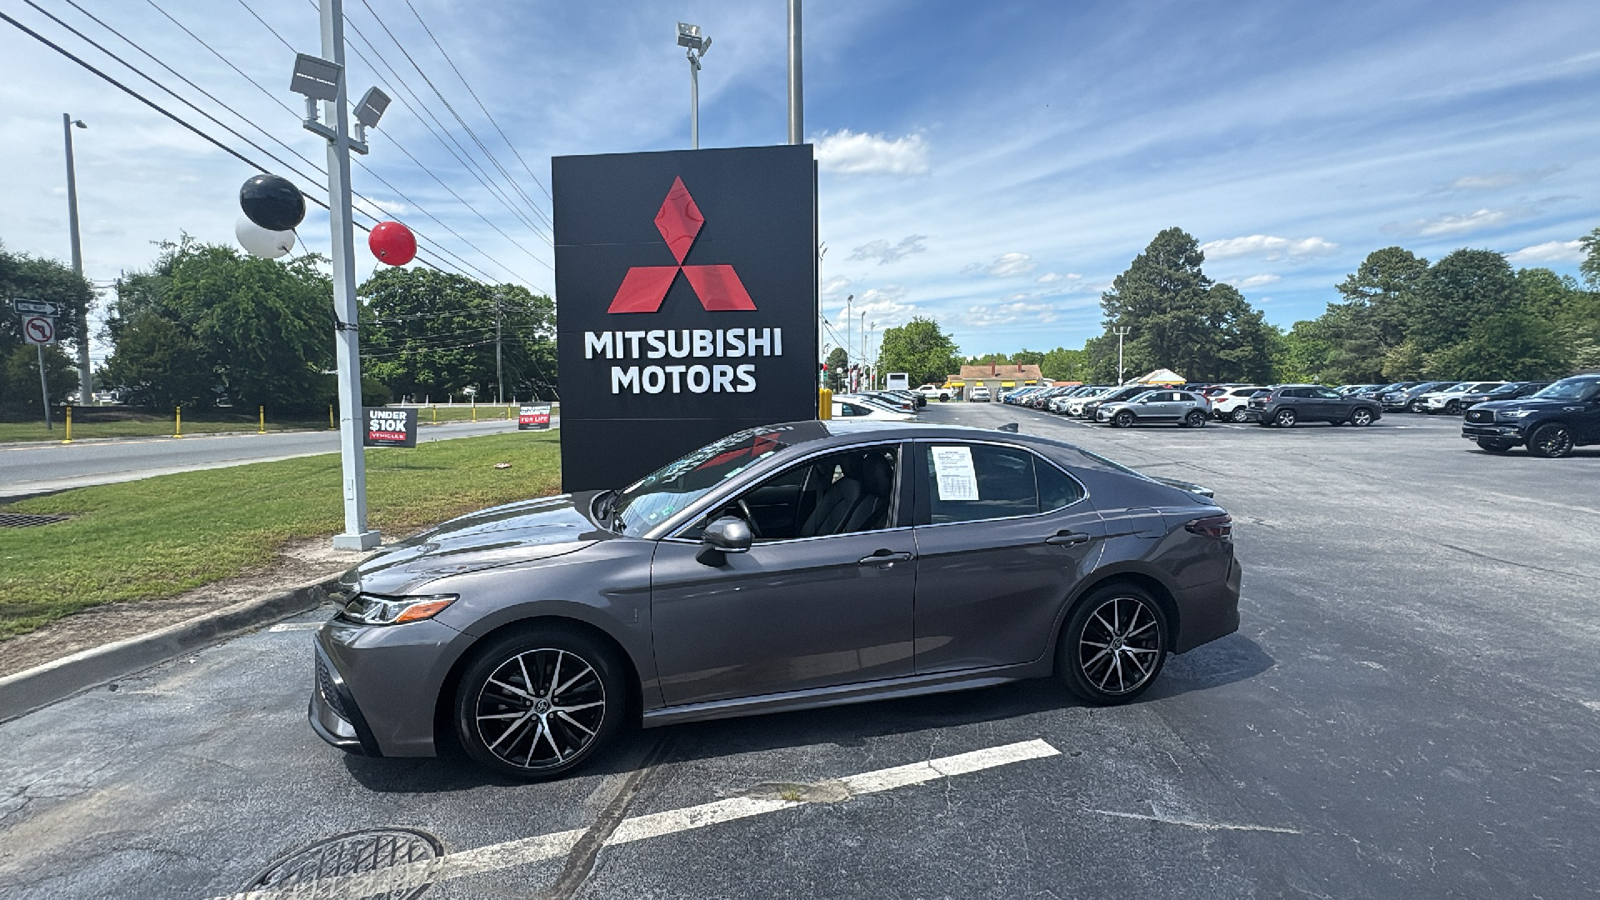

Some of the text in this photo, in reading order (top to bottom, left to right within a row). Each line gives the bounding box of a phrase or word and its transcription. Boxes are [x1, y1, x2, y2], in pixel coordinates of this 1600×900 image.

[584, 327, 783, 359] MITSUBISHI
[611, 364, 757, 394] MOTORS
[369, 410, 407, 420] UNDER
[369, 418, 407, 432] $10K
